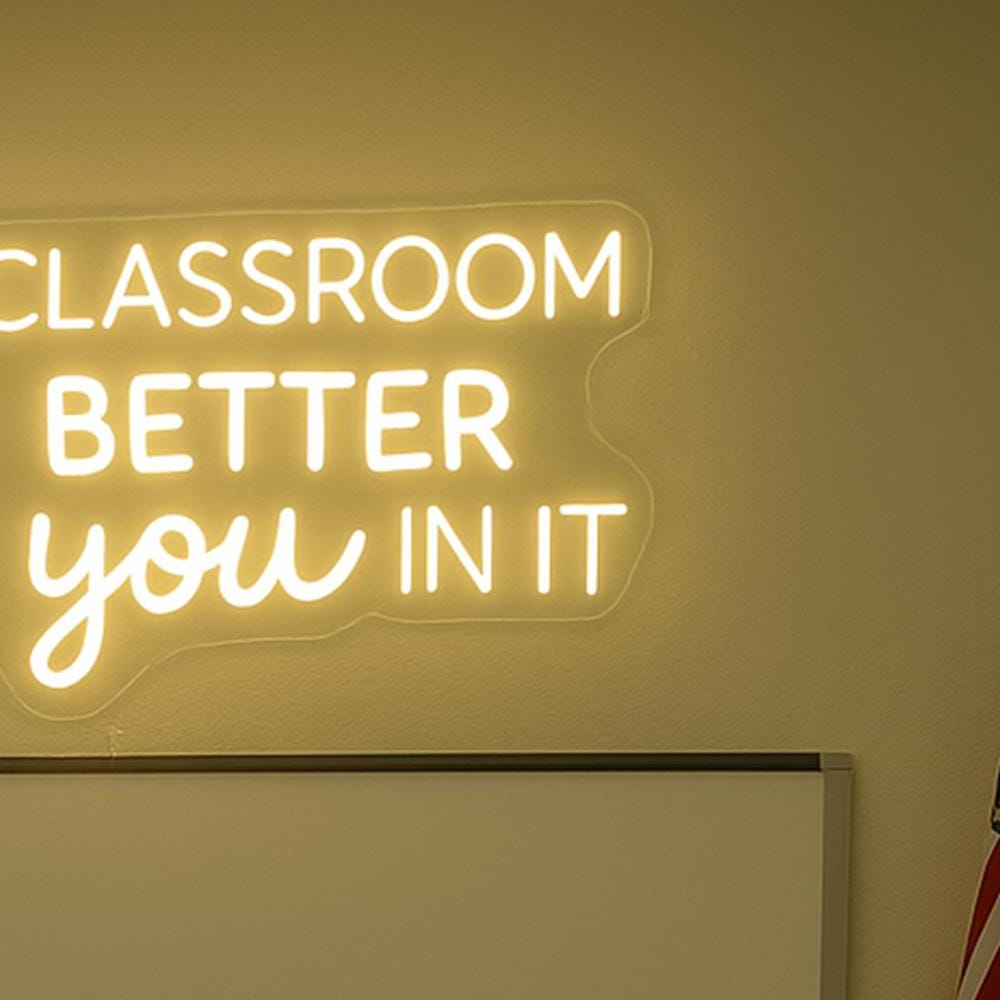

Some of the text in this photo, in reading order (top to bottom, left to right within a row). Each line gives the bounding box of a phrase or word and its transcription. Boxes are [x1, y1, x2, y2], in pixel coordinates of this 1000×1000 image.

[46, 368, 513, 476] BETTER
[28, 507, 366, 689] you
[401, 505, 493, 594] IN
[537, 503, 628, 596] IT
